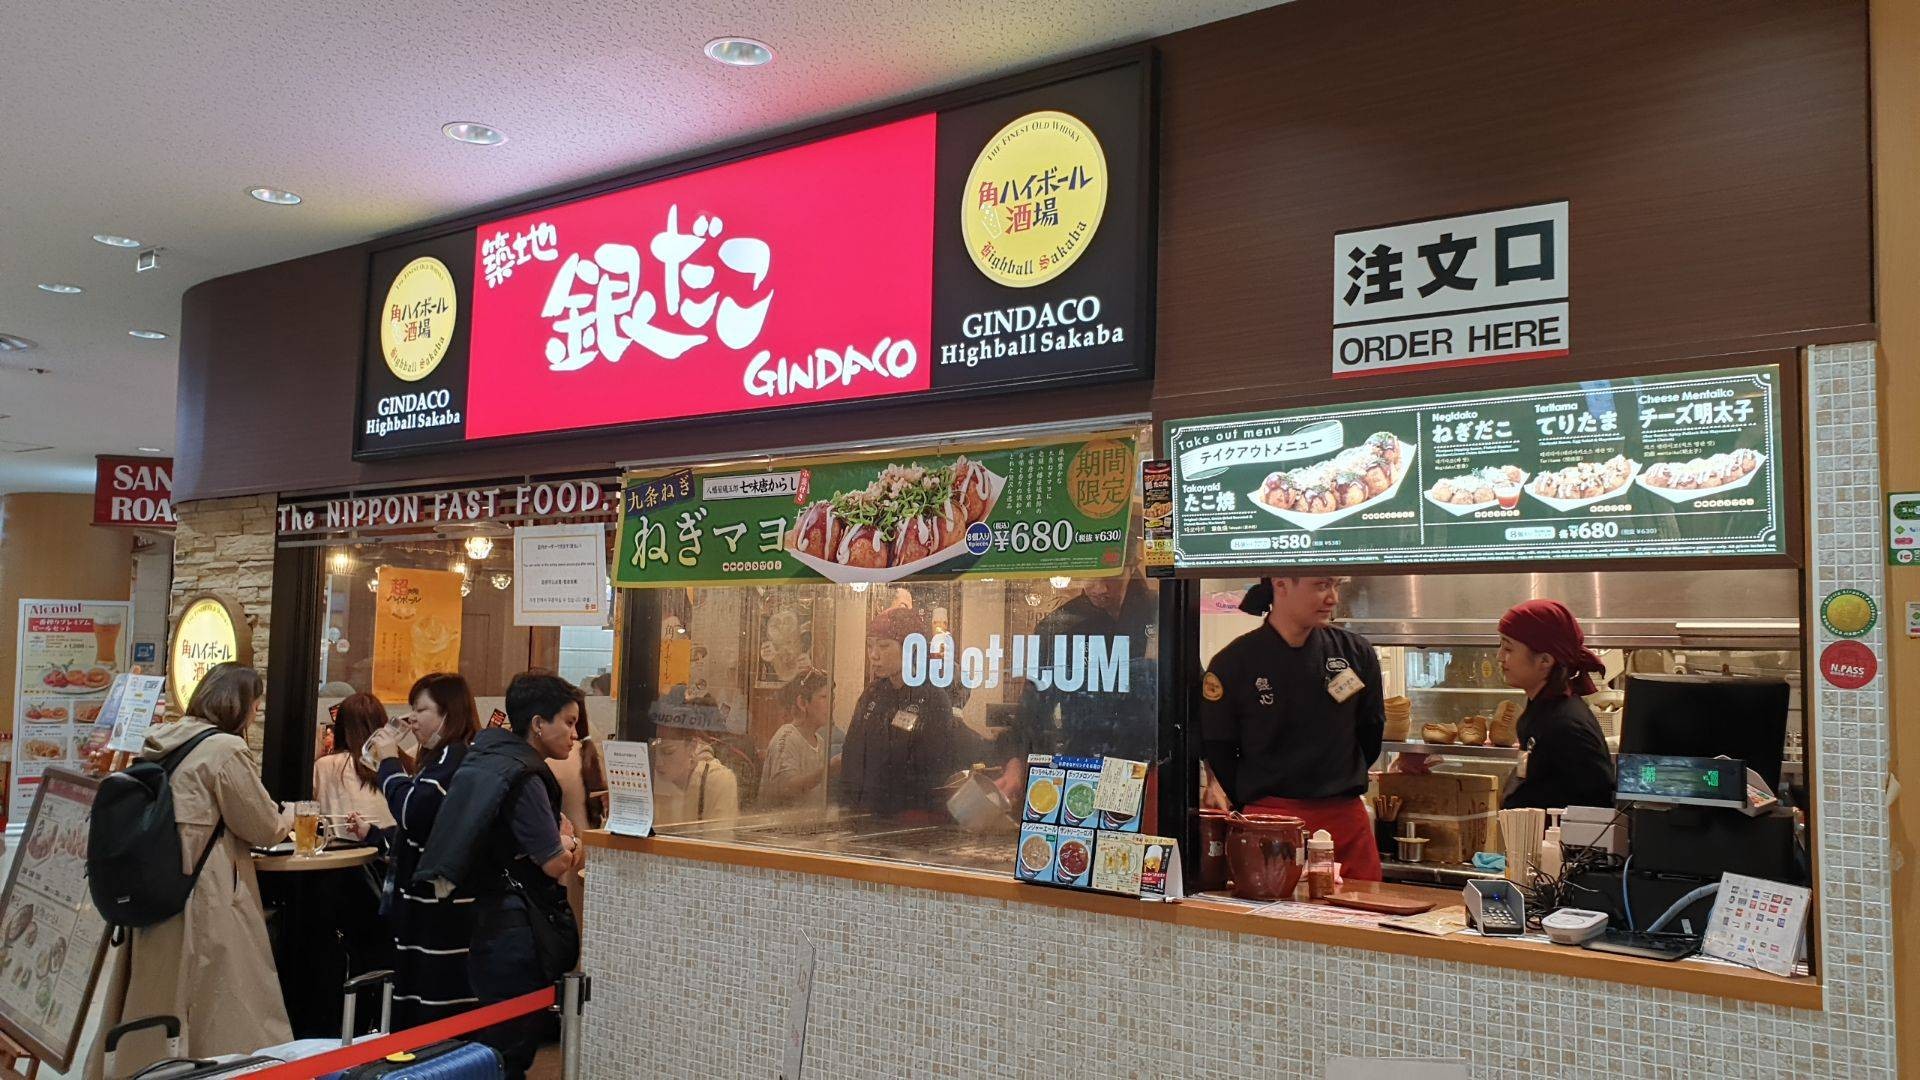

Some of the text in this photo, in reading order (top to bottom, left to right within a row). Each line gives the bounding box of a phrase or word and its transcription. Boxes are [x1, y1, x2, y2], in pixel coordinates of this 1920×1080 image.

[978, 165, 1094, 210] 角ハイボール
[1004, 197, 1059, 235] 酒場
[482, 222, 558, 288] 築地
[981, 221, 1088, 276] Highball Sakaba
[1343, 219, 1555, 306] 注文口
[541, 204, 773, 371] 銀だこ
[391, 297, 449, 322] 角ハイボール
[962, 296, 1101, 338] GINDACO
[403, 318, 431, 343] 酒場
[1340, 316, 1561, 365] ORDER HERE
[940, 324, 1124, 367] Highball Sakaba
[743, 336, 918, 397] GINDACO
[378, 389, 450, 416] GINDACO
[1637, 388, 1735, 405] Cheese Mentaiko
[366, 409, 461, 437] Highball Sakaba
[1432, 411, 1478, 423] Negidako
[1536, 410, 1618, 435] てりたま
[1639, 399, 1754, 428] チーズ明太子
[1178, 425, 1281, 451] Take out menu
[1432, 419, 1513, 443] ねぎだこ
[1076, 447, 1126, 478] 期間
[1200, 436, 1323, 465] テイクアウトメニュー
[113, 465, 173, 491] SAN
[740, 477, 797, 493] 七味唐からし
[1076, 478, 1125, 505] 限定
[277, 481, 609, 531] The NIPPON FAST FOOD.
[627, 474, 690, 513] 九条ねぎ
[1184, 491, 1235, 511] たこ焼
[111, 497, 178, 522] ROA
[631, 507, 787, 569] ねぎマヨ
[994, 520, 1073, 552] ¥680
[30, 602, 83, 615] Alcohol
[182, 639, 232, 660] 角ハイボール
[1831, 664, 1865, 675] N.PASS
